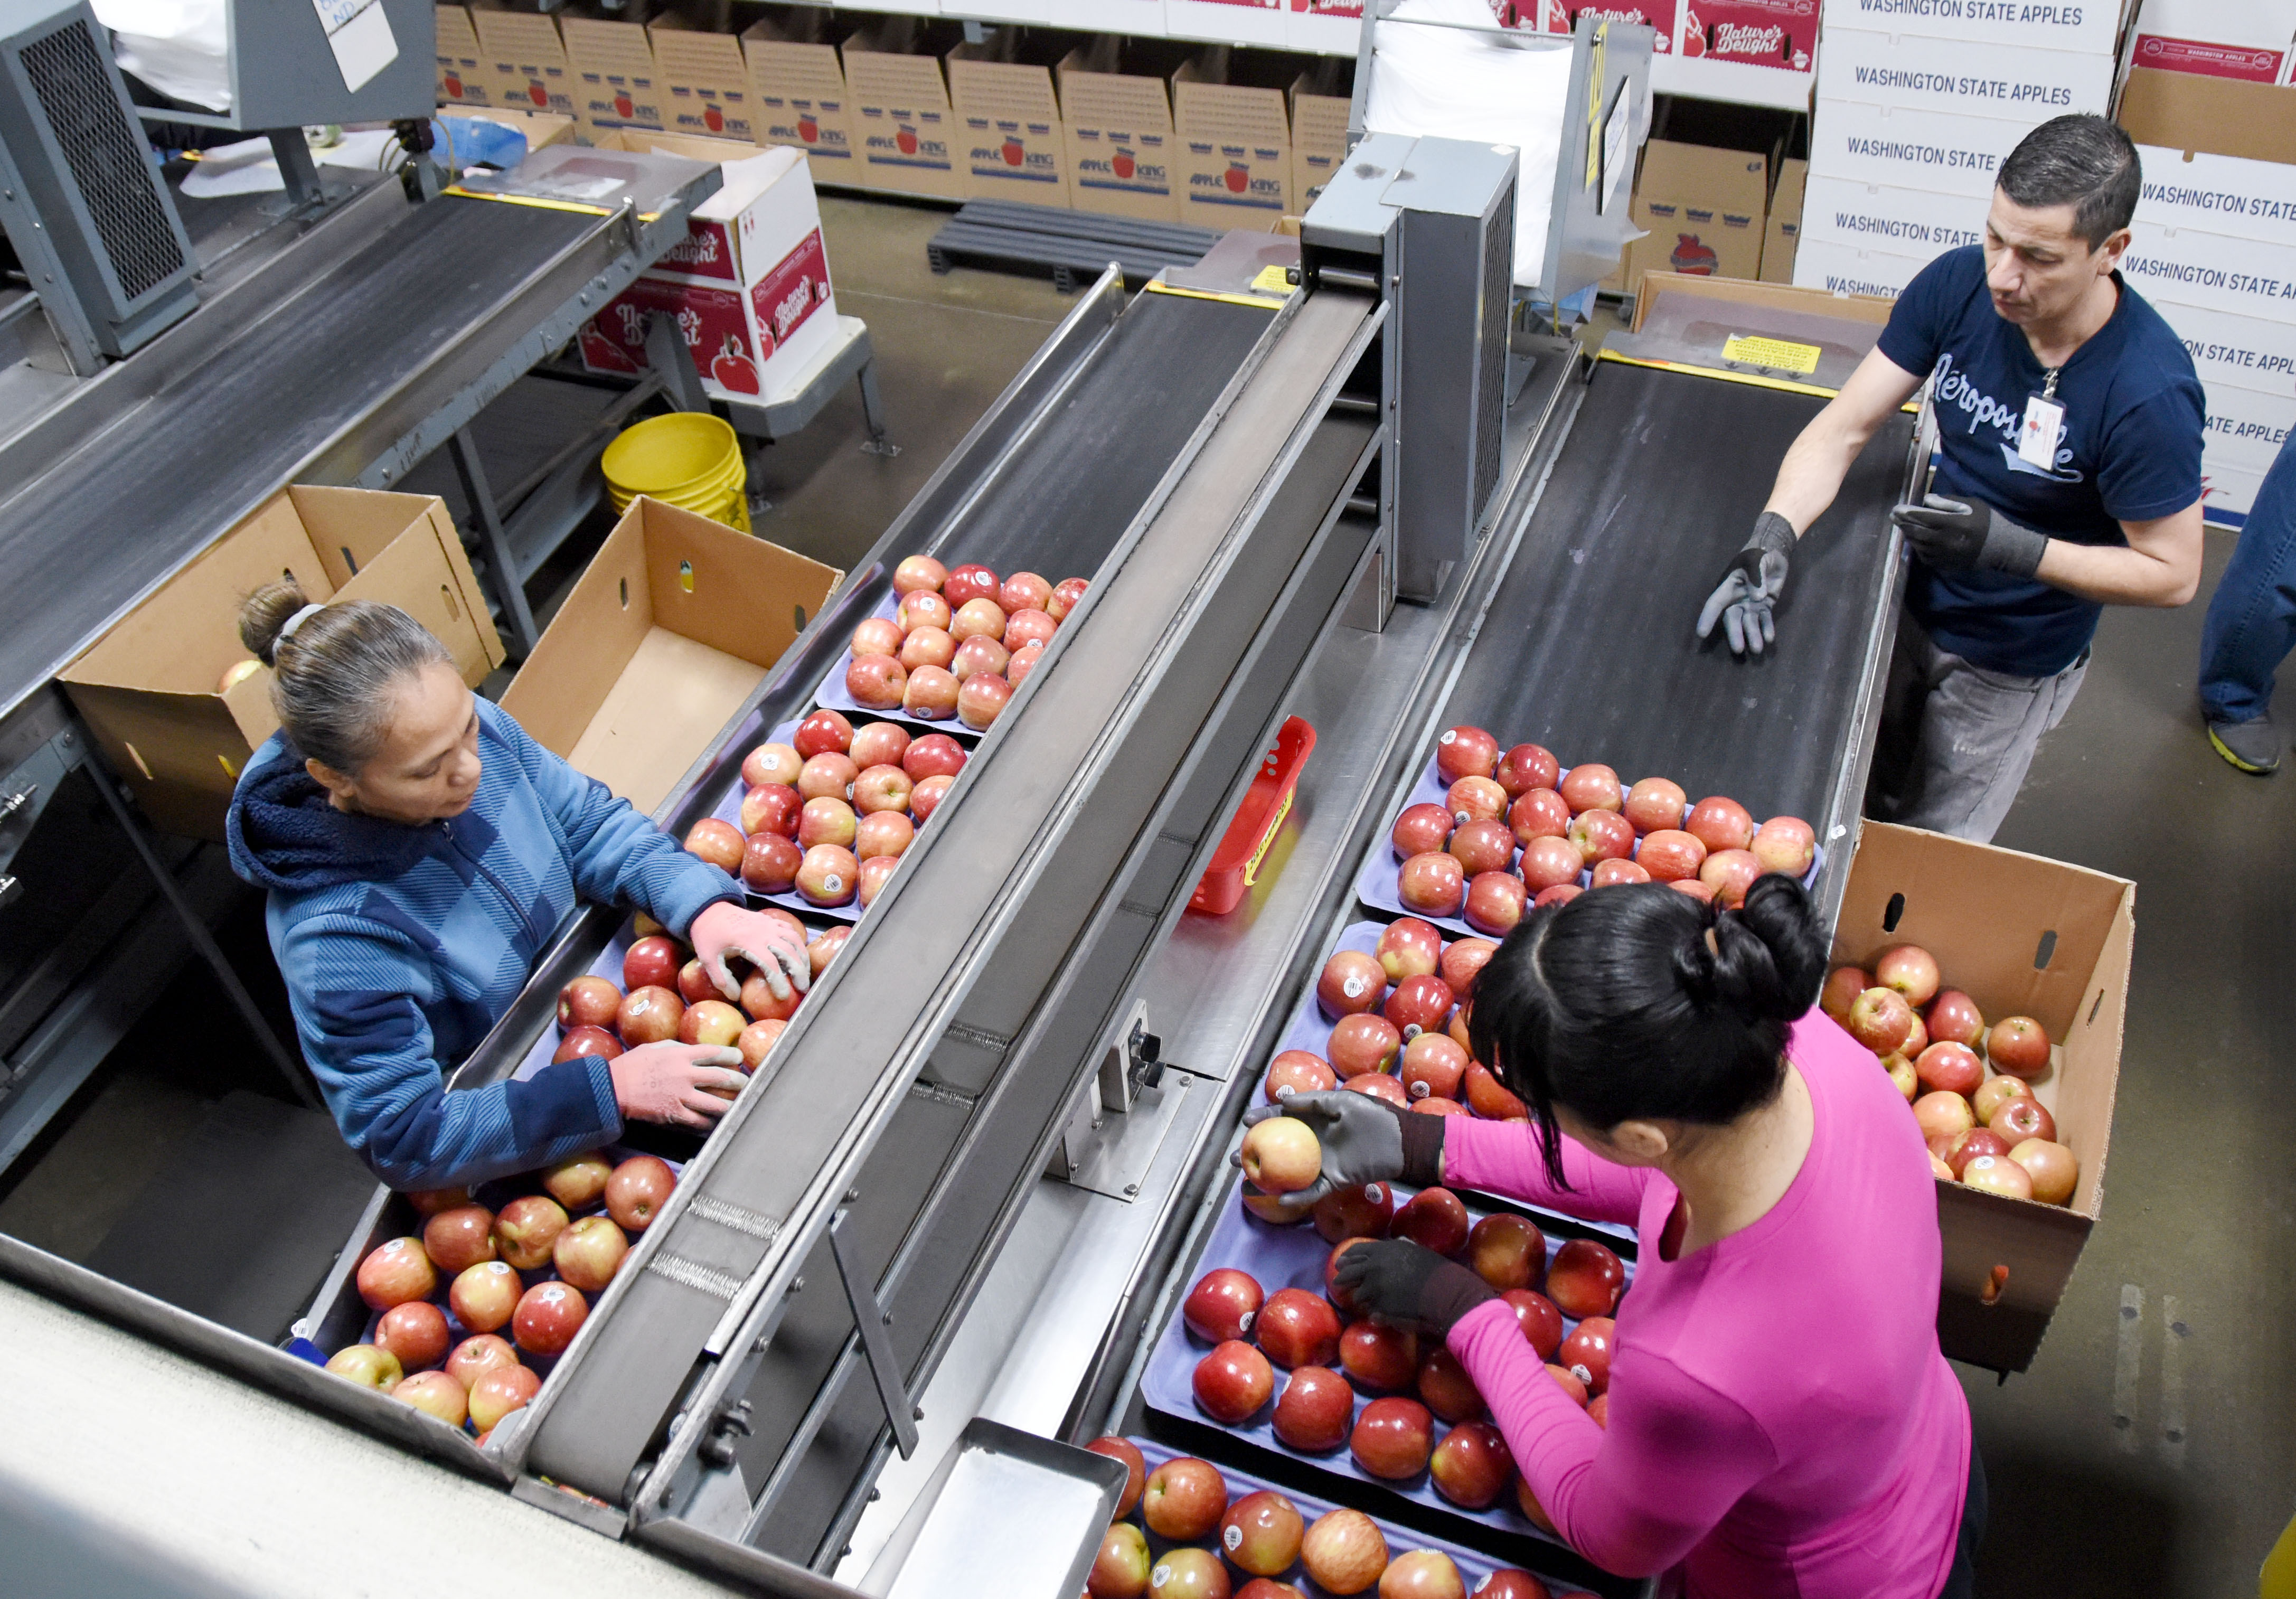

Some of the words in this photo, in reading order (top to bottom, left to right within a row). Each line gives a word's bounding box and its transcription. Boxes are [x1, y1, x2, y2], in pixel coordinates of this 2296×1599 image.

[1860, 0, 1962, 17] WASHINGTON
[1966, 1, 2017, 21] STATE
[2020, 5, 2083, 25] APPLES
[1717, 23, 1785, 40] Nature's
[1716, 37, 1779, 55] Delight
[1855, 66, 1955, 93] WASHINGTON
[1959, 78, 2007, 99] STATE
[2010, 83, 2072, 105] APPLES
[1848, 136, 1945, 165] WASHINGTON
[1948, 149, 1996, 172] STATE
[1190, 173, 1224, 187] APPLE
[1250, 177, 1281, 193] KING
[2142, 183, 2247, 214] WASHINGTON
[2249, 198, 2296, 221] STATE
[1836, 212, 1930, 241] WASHINGTON
[1933, 227, 1979, 246] STATE
[1826, 275, 1905, 298] WASHINGT
[2125, 255, 2227, 288] WASHINGTON
[2228, 274, 2280, 297] STATE
[2206, 344, 2255, 367] STATE
[2256, 354, 2296, 375] APPL
[2205, 415, 2234, 434] ATE
